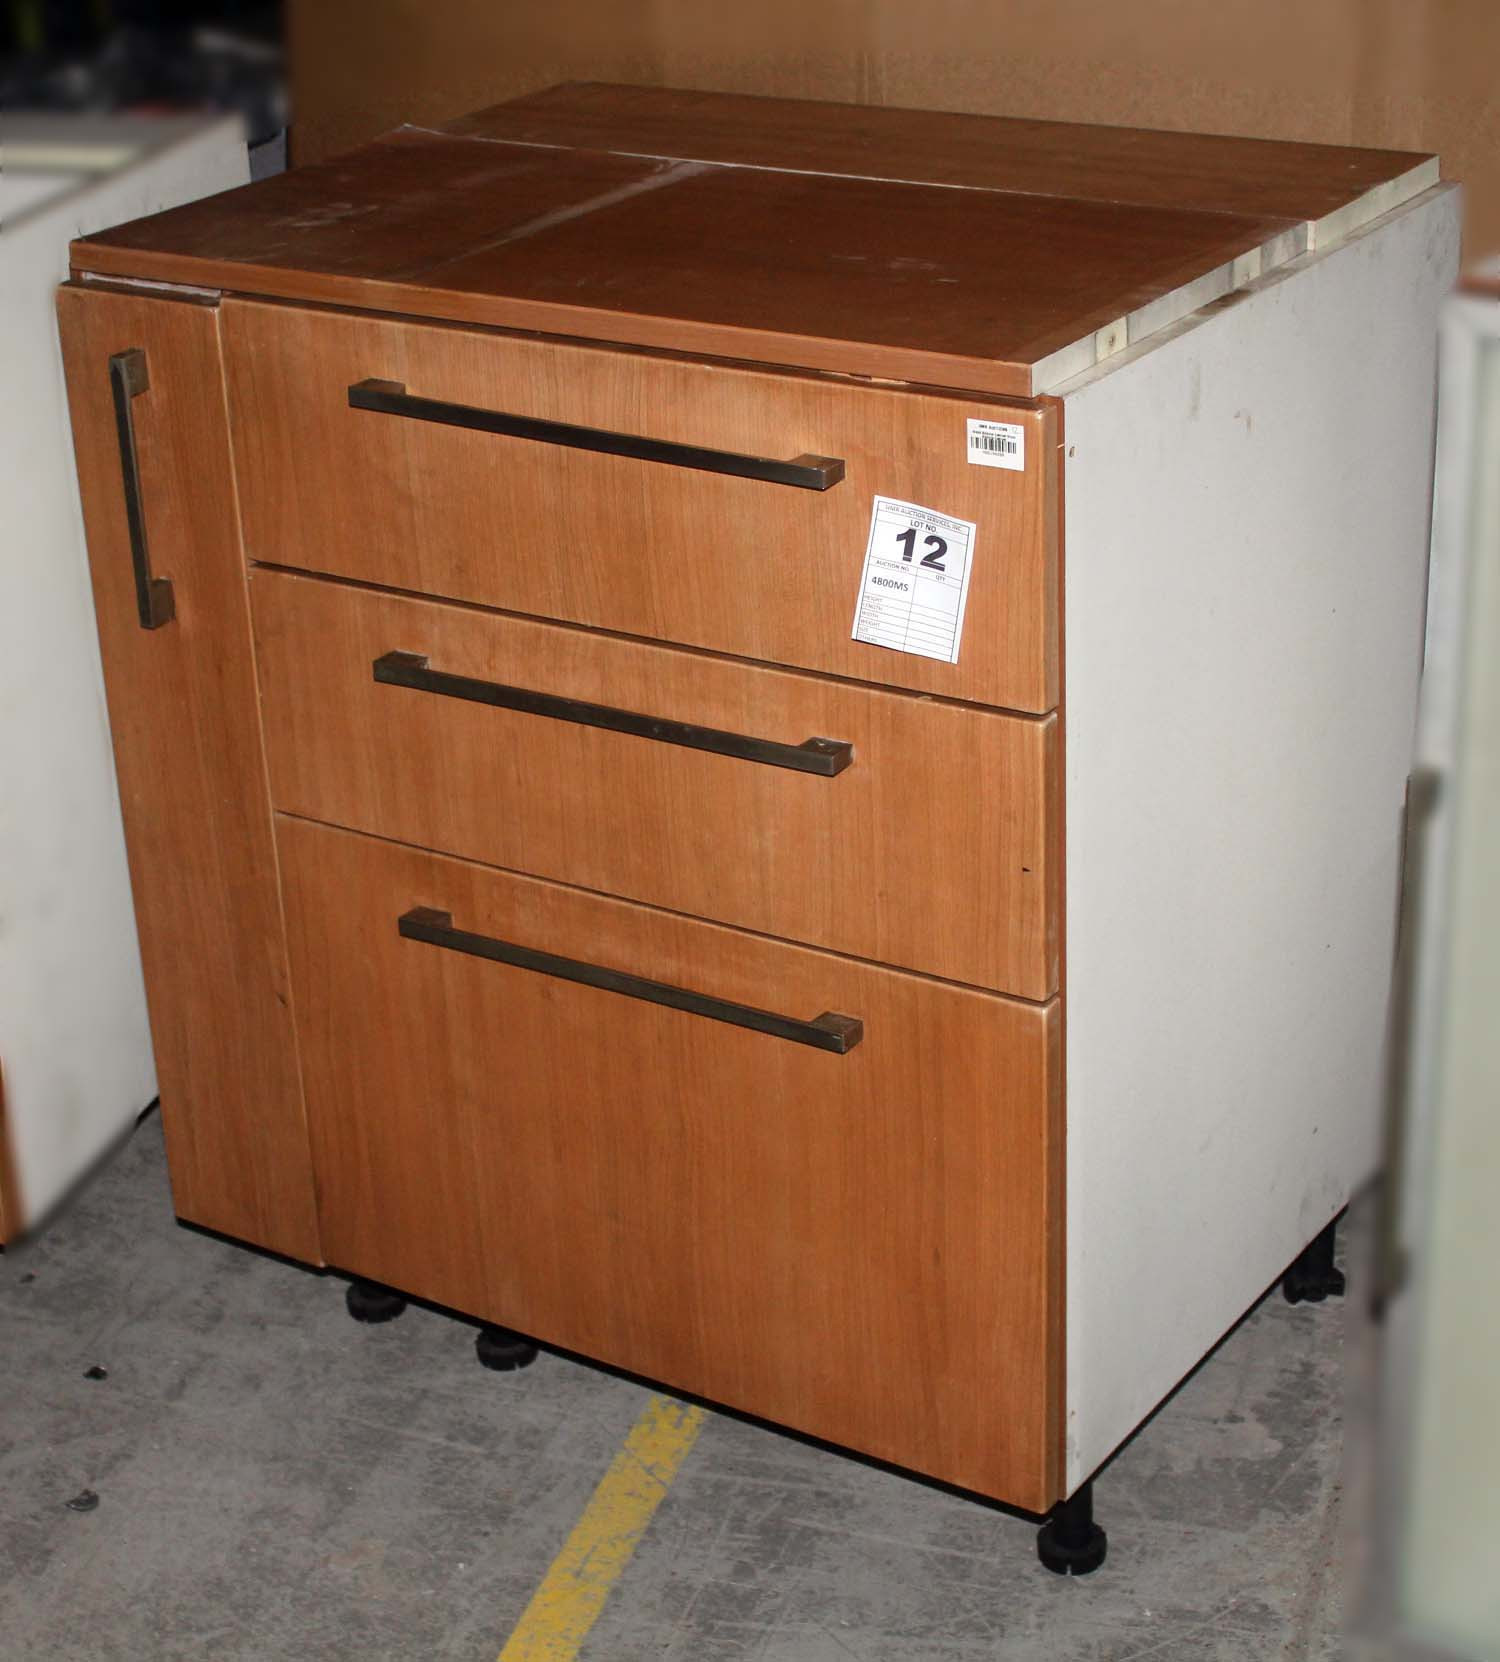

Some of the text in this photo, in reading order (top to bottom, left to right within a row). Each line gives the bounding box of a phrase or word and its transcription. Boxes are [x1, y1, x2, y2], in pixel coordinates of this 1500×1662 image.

[900, 507, 926, 520] AUCTION
[910, 519, 925, 529] LOT
[896, 528, 948, 572] 12
[876, 559, 900, 569] AUCTION
[871, 576, 909, 592] 4800MS
